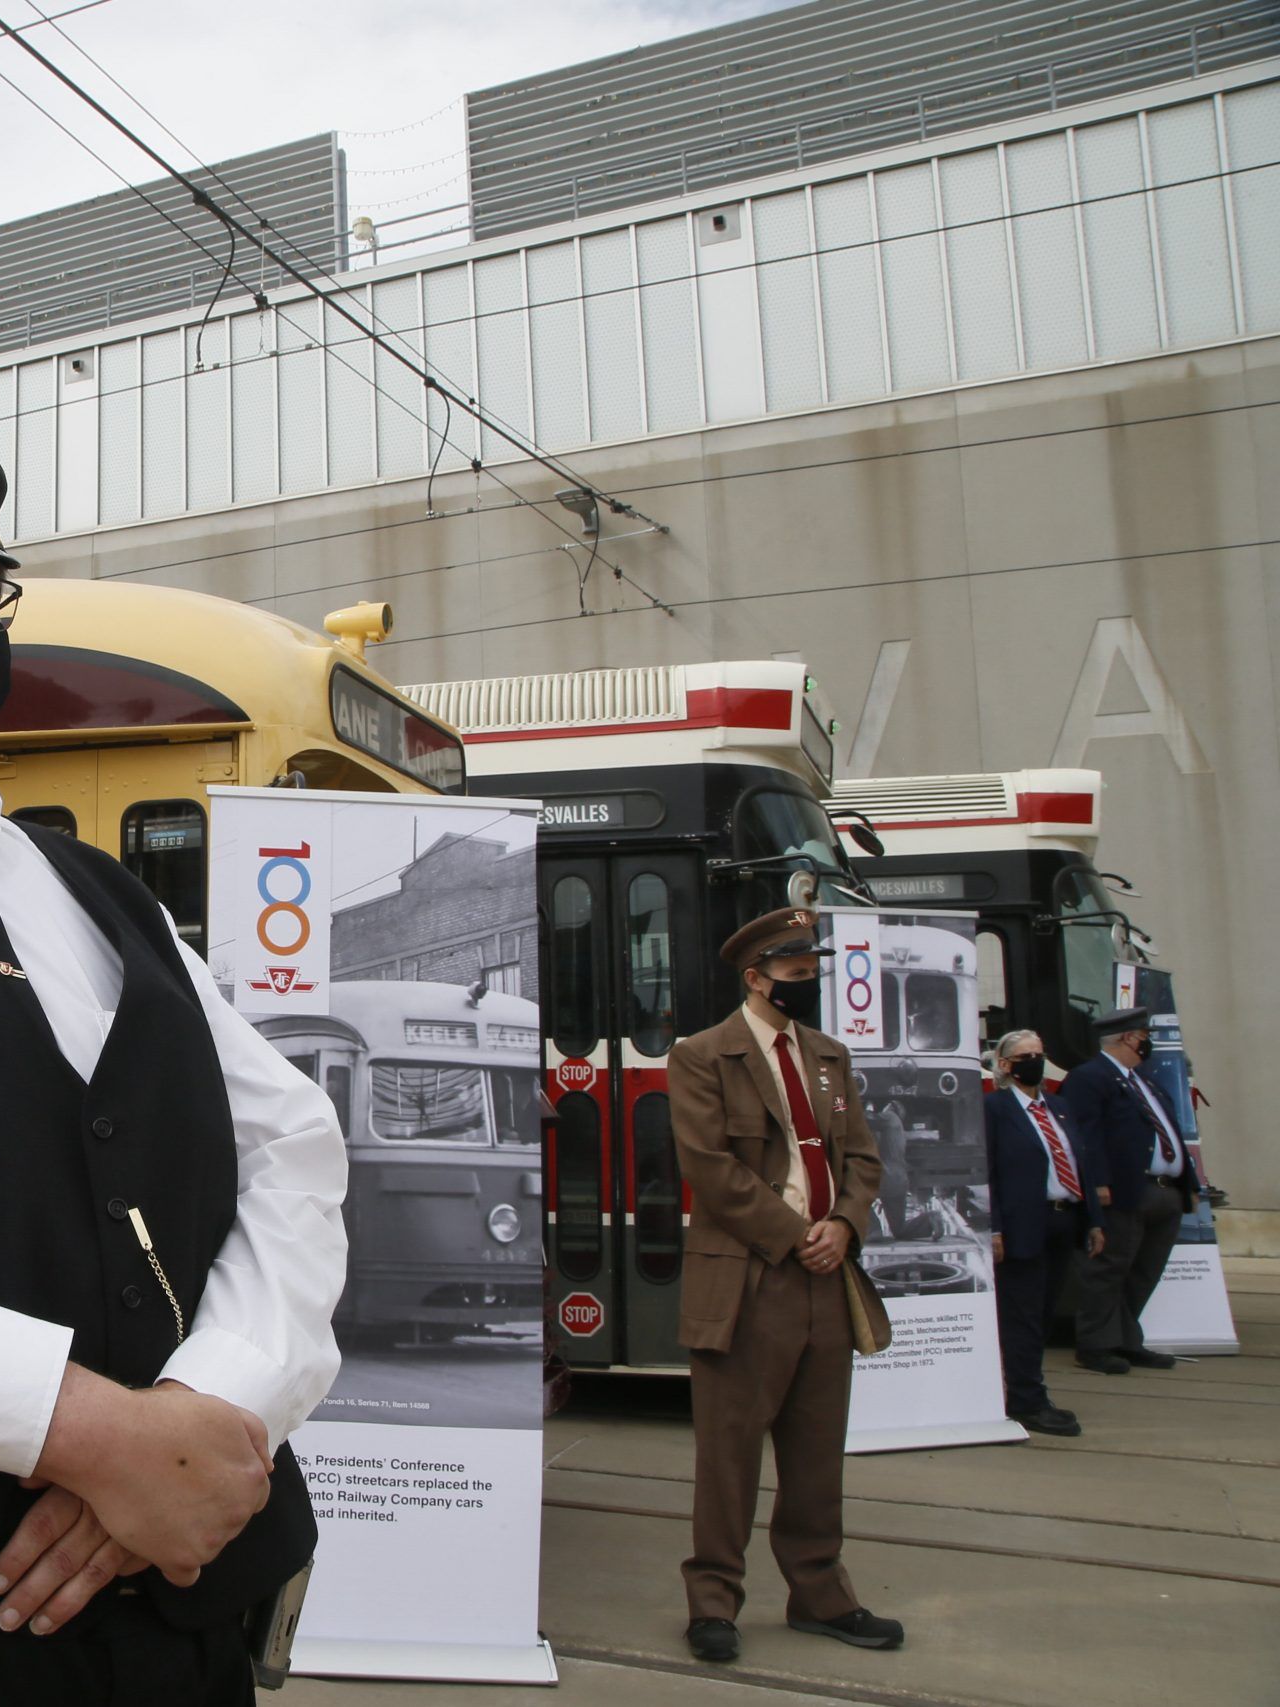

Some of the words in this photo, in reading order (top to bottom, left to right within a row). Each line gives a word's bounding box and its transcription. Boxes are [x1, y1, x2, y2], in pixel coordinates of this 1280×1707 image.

[536, 804, 609, 825] ESVALLES
[257, 841, 312, 957] 100
[845, 939, 872, 1012] 100
[561, 1065, 591, 1081] STOP
[565, 1306, 599, 1323] STOP
[959, 1313, 973, 1321] TTC
[888, 1350, 922, 1358] Committee
[944, 1346, 973, 1354] streetcar
[892, 1340, 914, 1348] battery
[868, 1362, 891, 1371] Harvey
[893, 1361, 910, 1369] Shop
[323, 1398, 345, 1406] Fonds
[358, 1399, 380, 1407] Series
[381, 1400, 391, 1408] 71,
[316, 1455, 386, 1469] Presidents'
[390, 1459, 465, 1473] Conference
[304, 1472, 341, 1486] (PCC)
[345, 1474, 409, 1487] streetcars
[413, 1478, 469, 1492] replaced
[472, 1480, 493, 1491] the
[338, 1490, 387, 1506] Railway
[390, 1493, 452, 1510] Company
[455, 1498, 484, 1508] cars
[338, 1508, 398, 1522] inherited.
